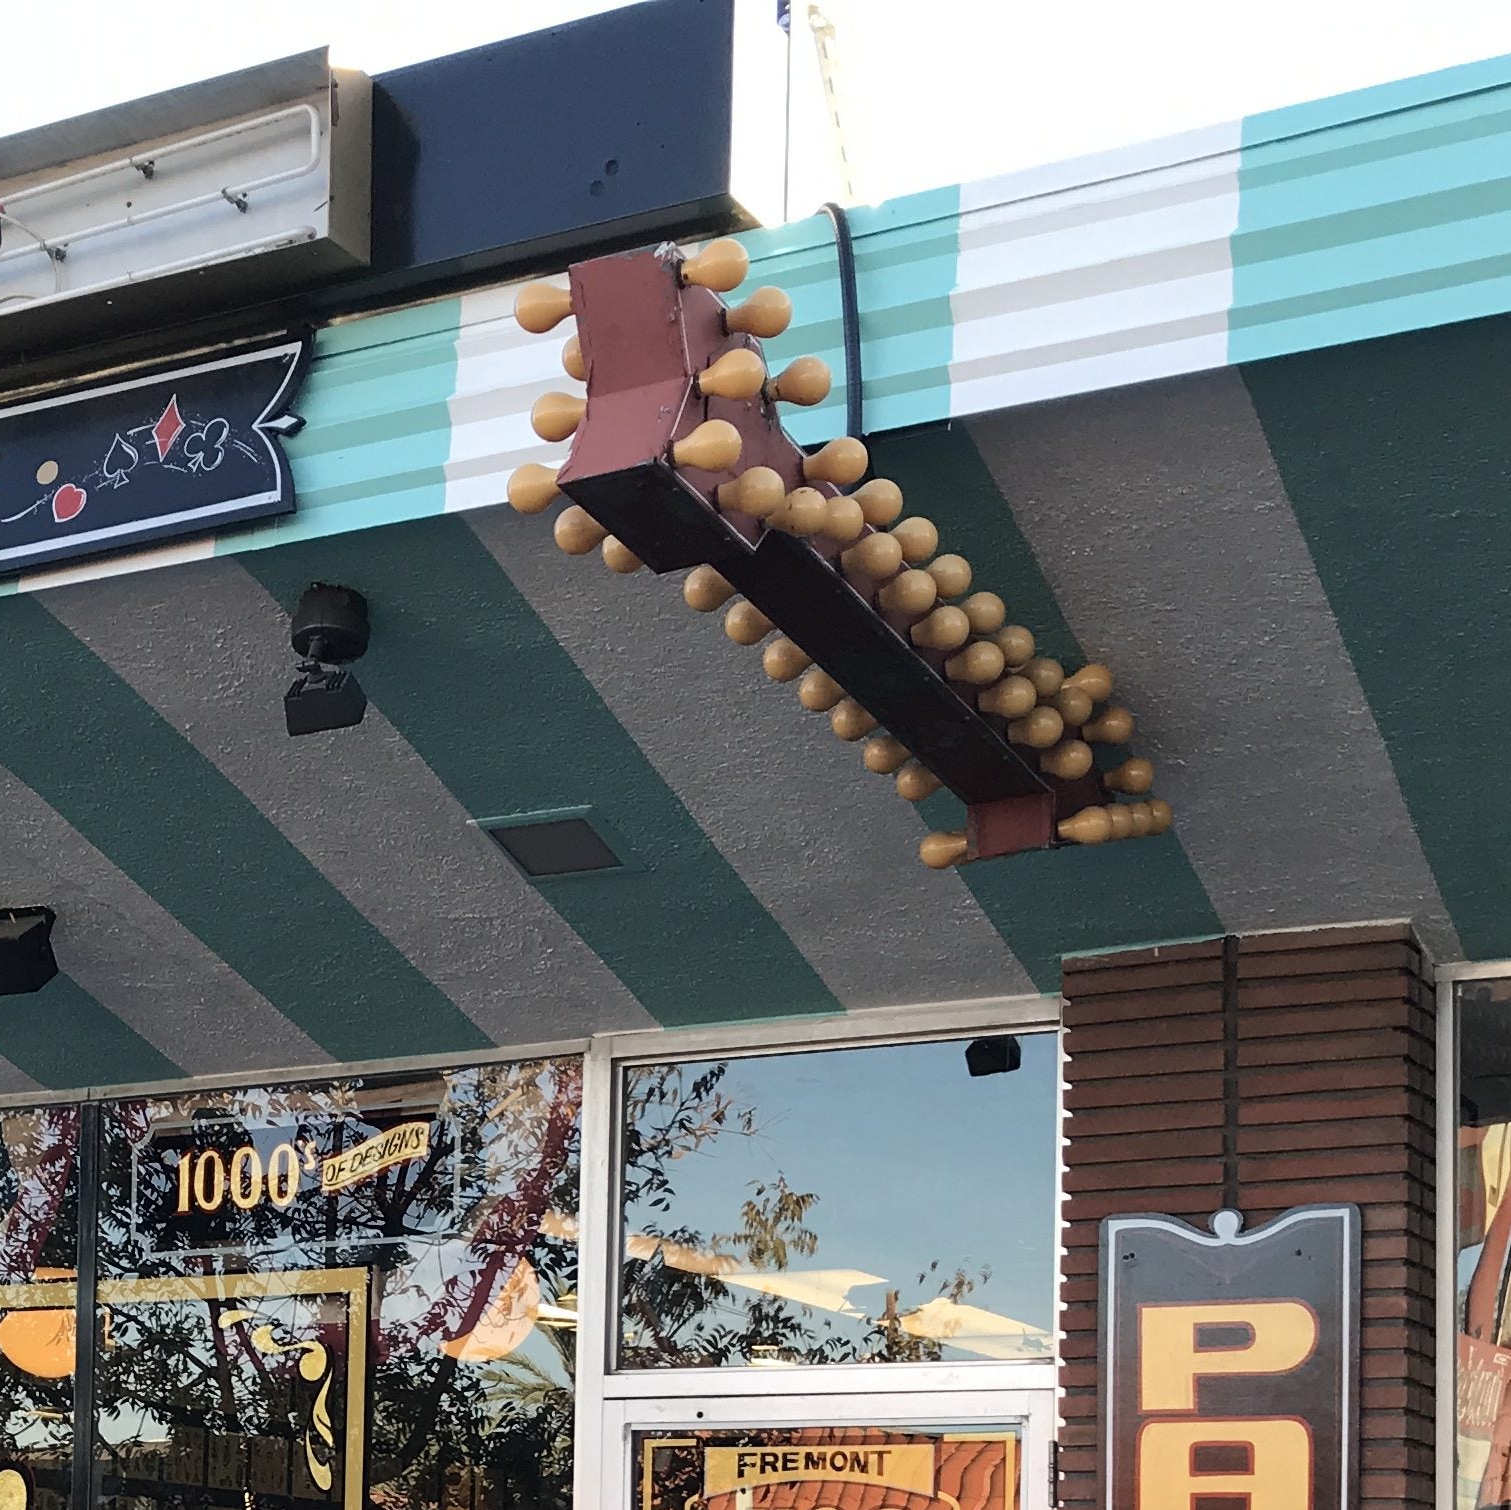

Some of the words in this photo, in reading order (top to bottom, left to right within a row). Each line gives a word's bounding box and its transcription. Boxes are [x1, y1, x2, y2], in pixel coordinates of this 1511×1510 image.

[324, 1160, 347, 1184] OF
[350, 1125, 426, 1174] DESIGNS
[736, 1448, 892, 1479] FREMONT
